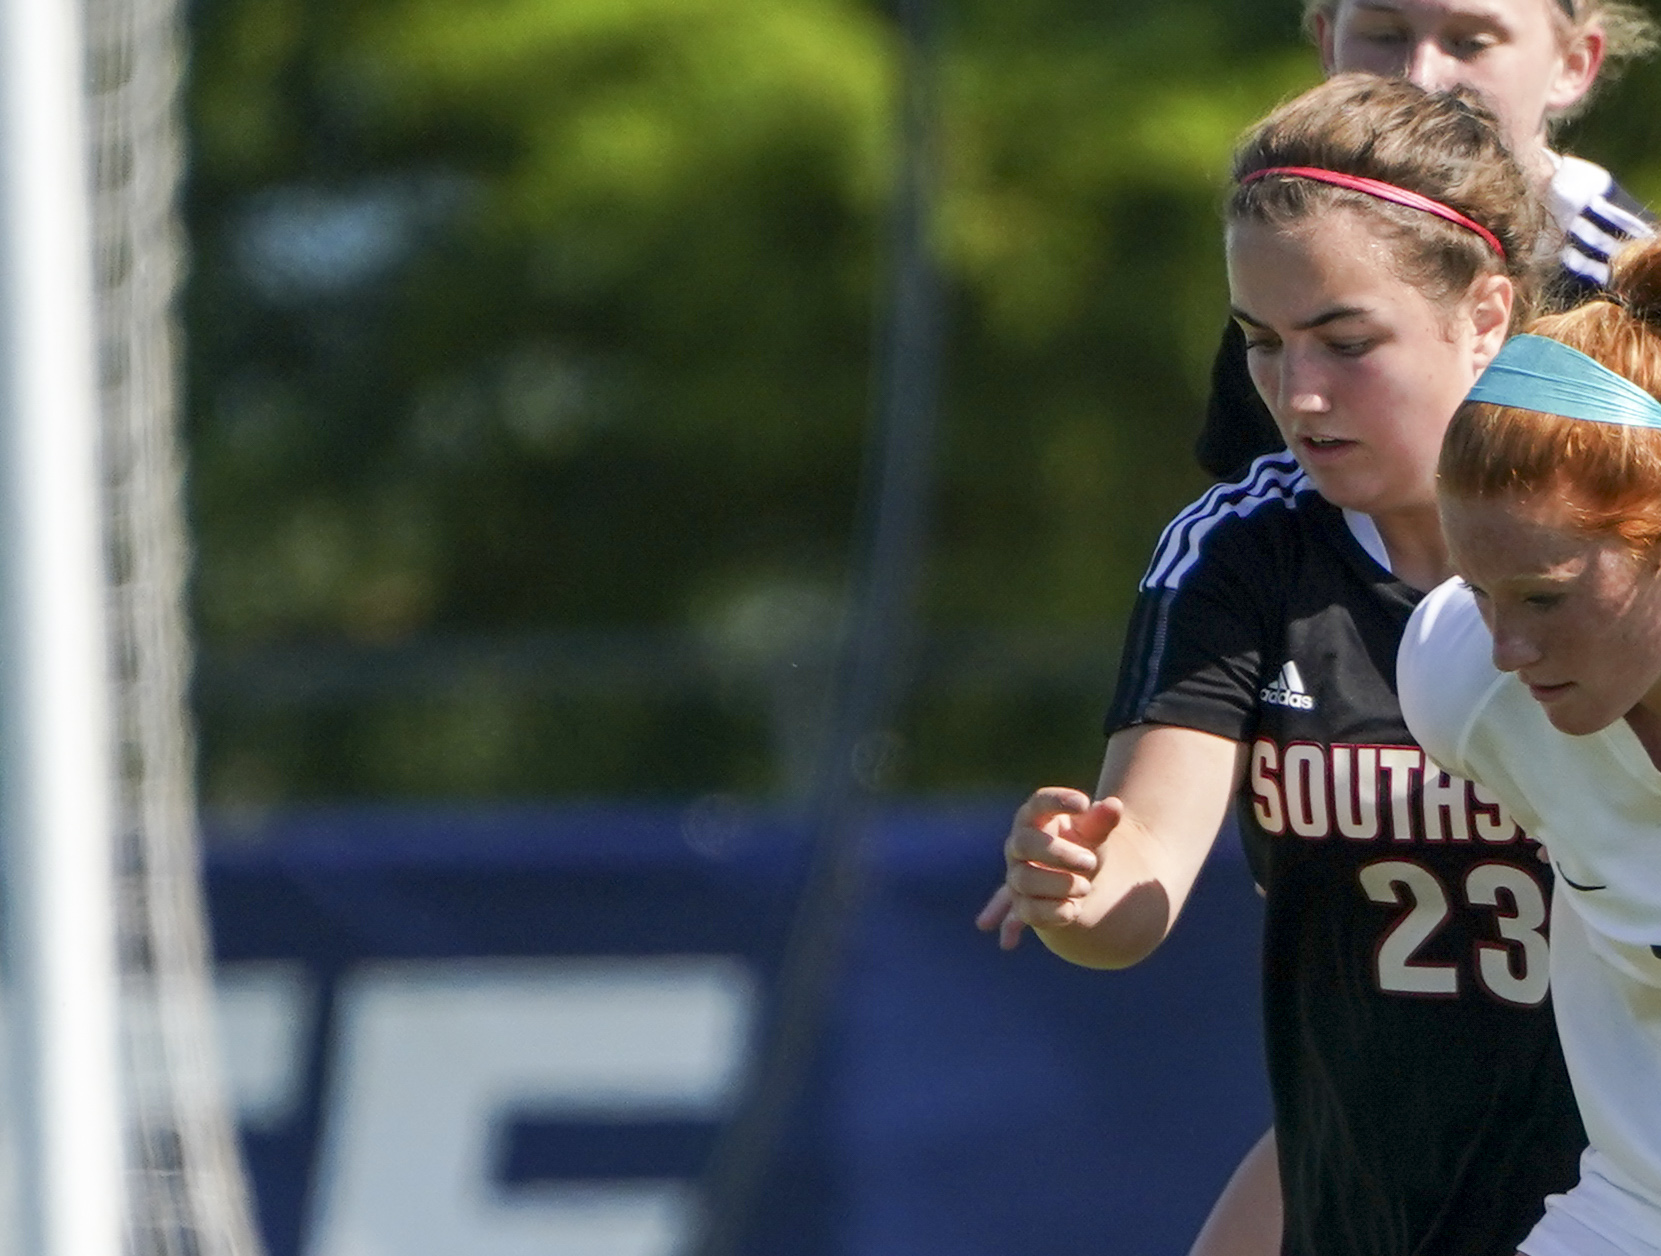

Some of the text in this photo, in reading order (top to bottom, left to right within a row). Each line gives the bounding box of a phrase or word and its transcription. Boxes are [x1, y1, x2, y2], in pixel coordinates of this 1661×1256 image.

[1260, 688, 1314, 710] addas
[1249, 736, 1541, 845] SOUTHS
[1357, 857, 1551, 1009] 23
